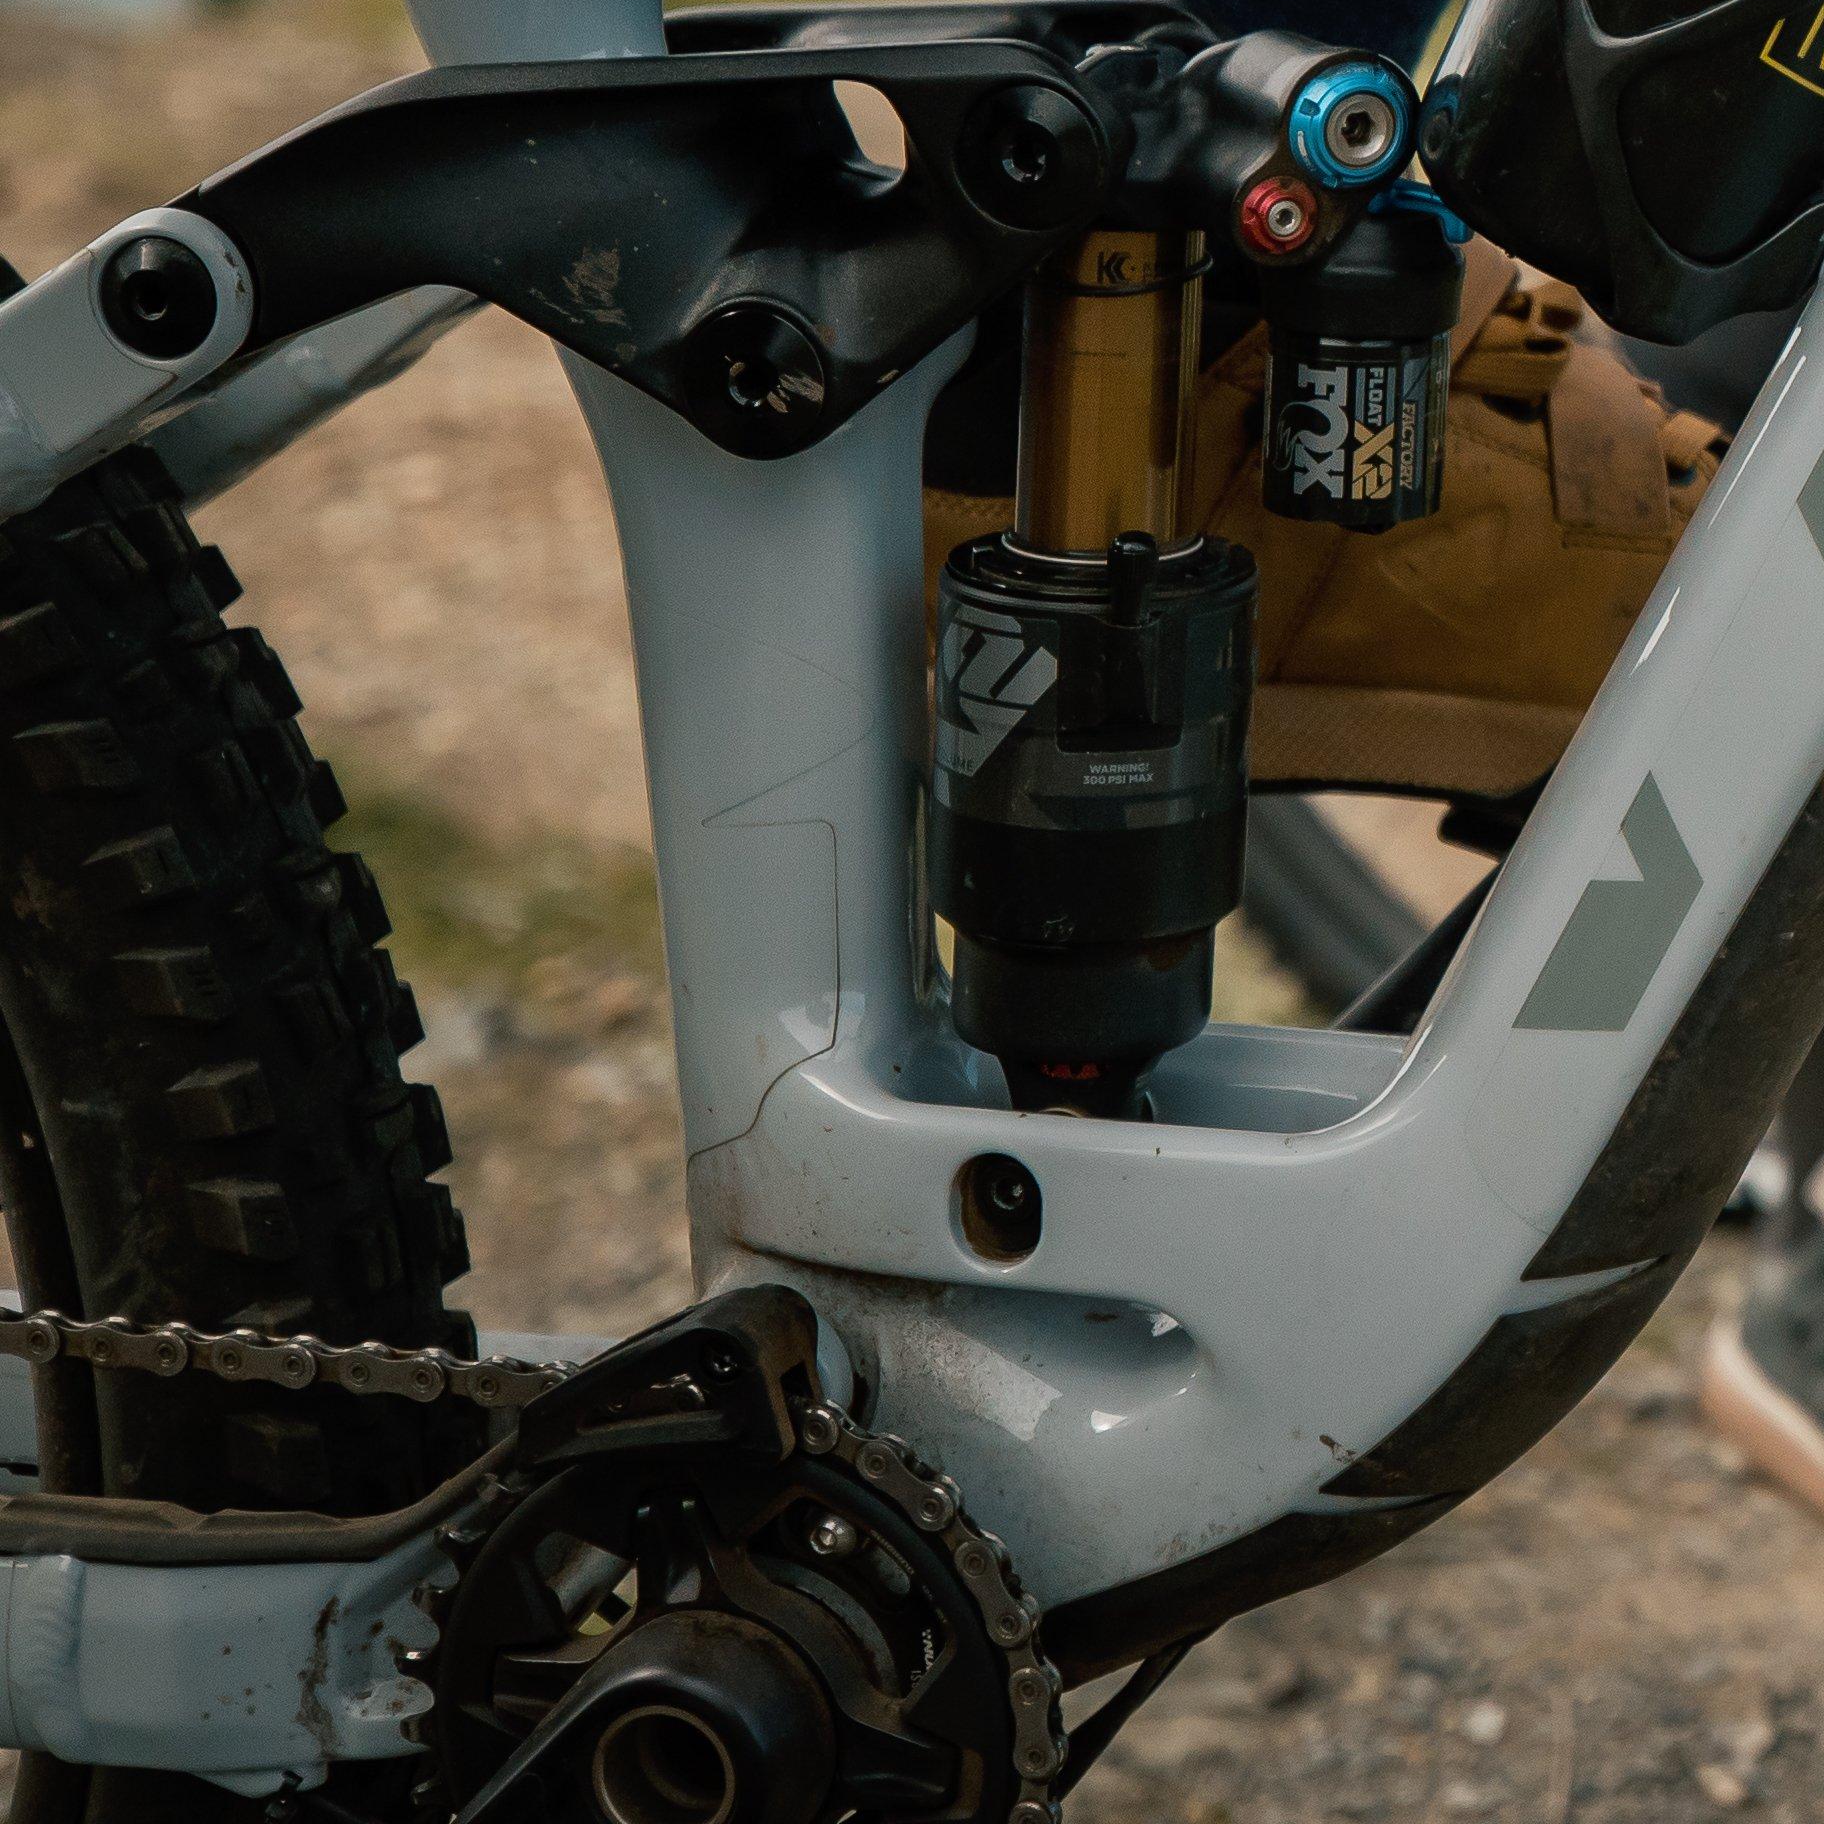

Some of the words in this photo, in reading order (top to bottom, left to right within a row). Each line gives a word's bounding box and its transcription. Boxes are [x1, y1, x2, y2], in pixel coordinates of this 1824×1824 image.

[1278, 363, 1349, 499] FOX
[1367, 367, 1385, 426] FLOAT
[1400, 402, 1417, 490] FACTORY
[1108, 775, 1126, 784] PSI
[1129, 773, 1153, 784] MAX
